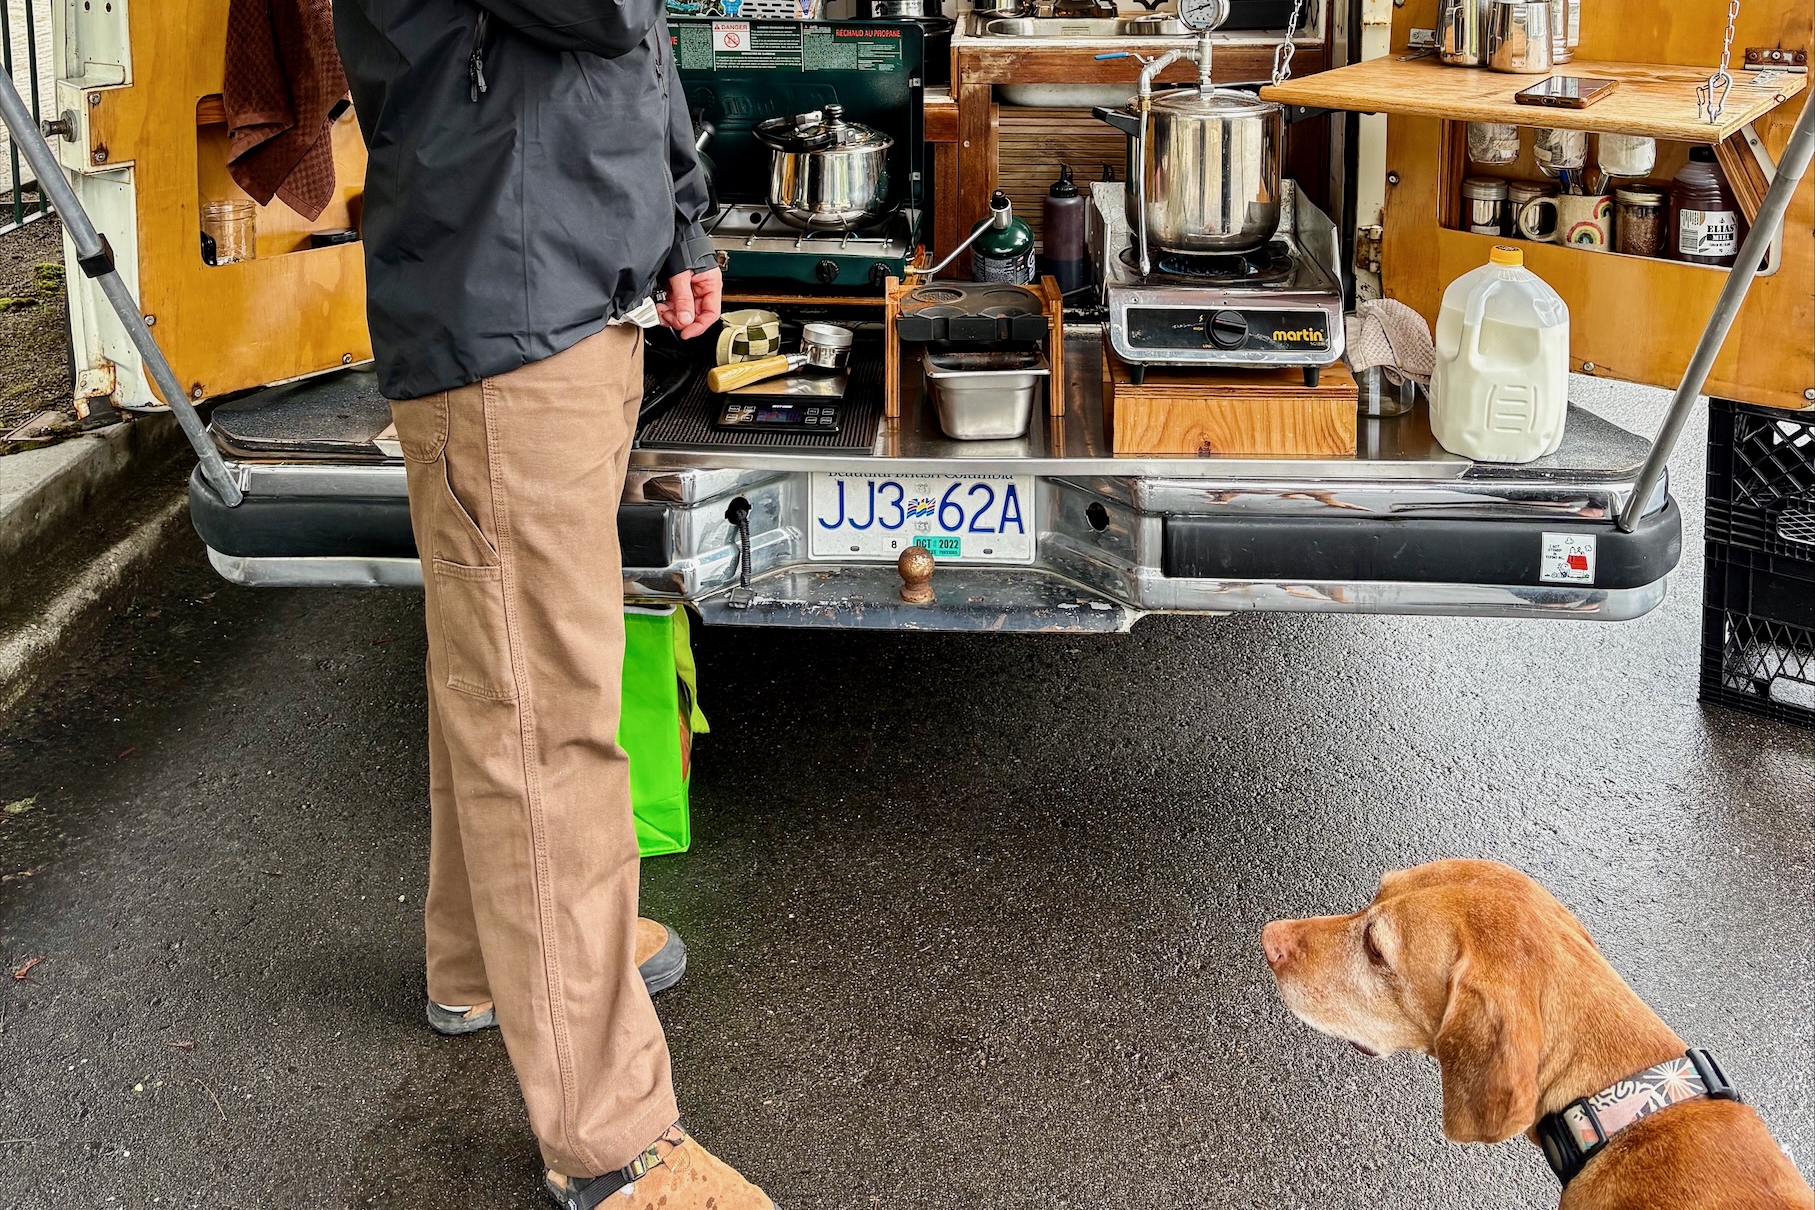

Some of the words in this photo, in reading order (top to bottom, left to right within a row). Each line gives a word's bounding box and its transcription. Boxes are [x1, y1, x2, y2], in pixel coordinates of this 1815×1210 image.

[873, 30, 901, 38] PROPANE
[1272, 327, 1323, 342] martin
[818, 480, 905, 530] JJ3
[938, 482, 1025, 534] 62A
[891, 540, 897, 549] 8
[916, 539, 932, 549] OCT
[939, 539, 959, 549] 2022
